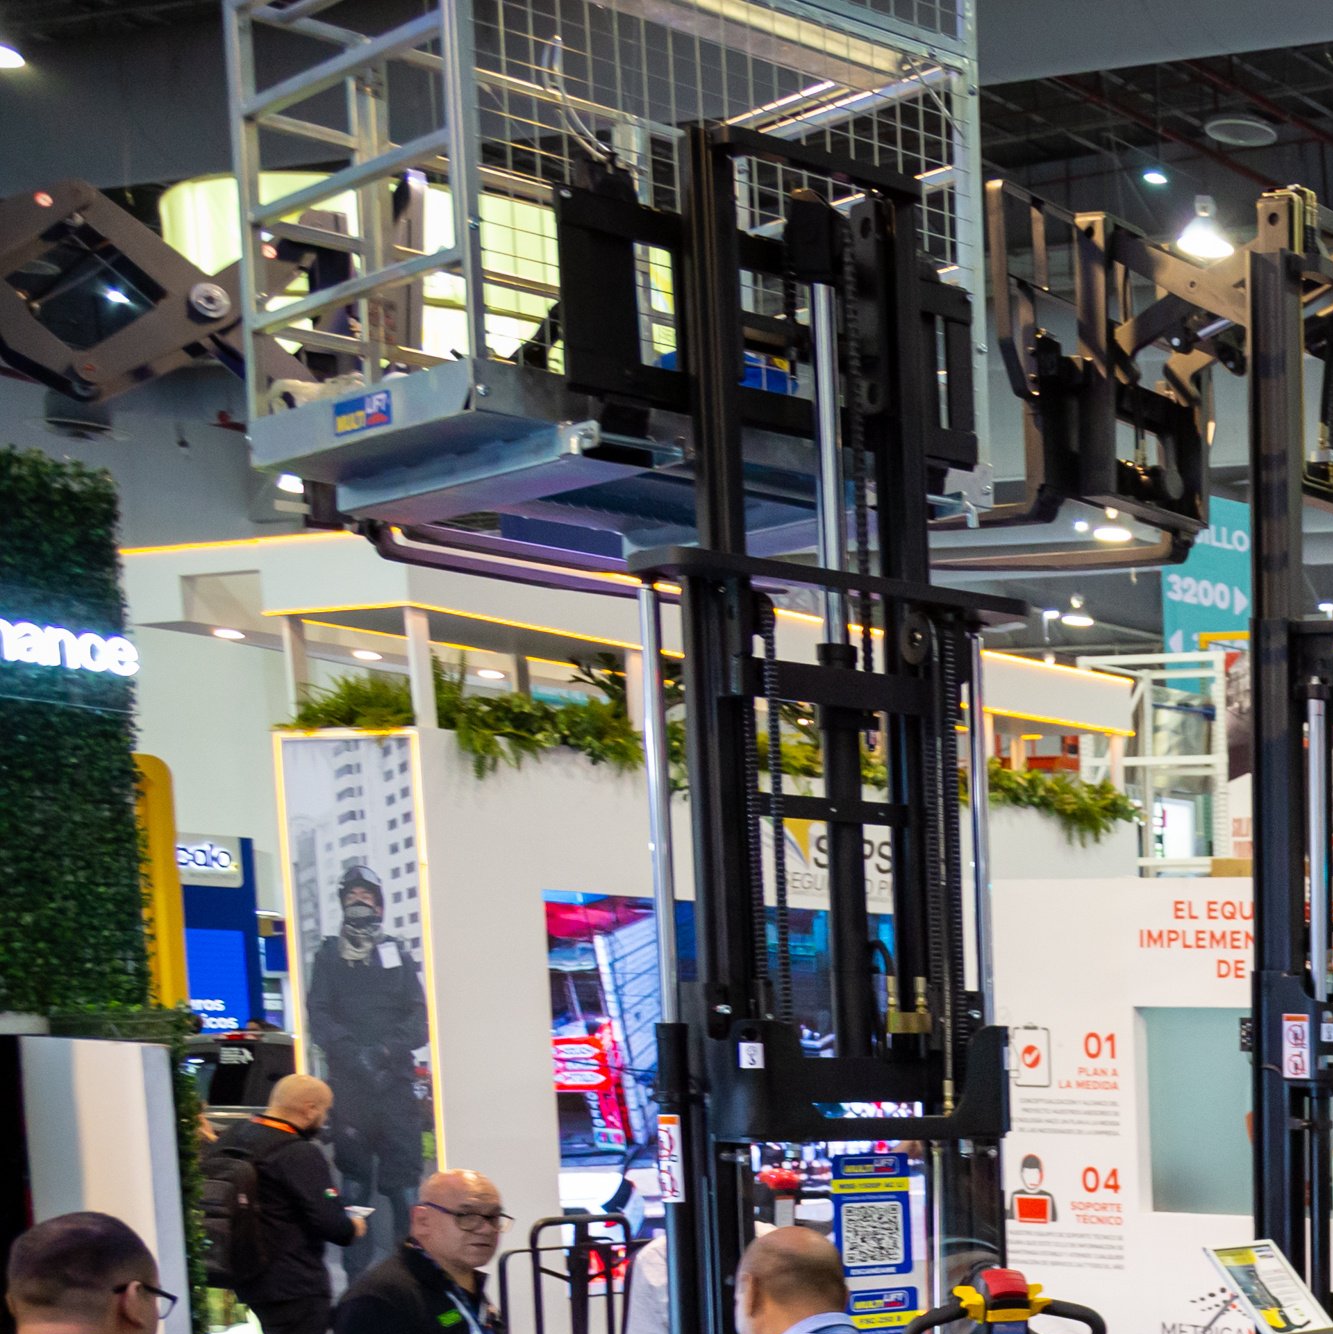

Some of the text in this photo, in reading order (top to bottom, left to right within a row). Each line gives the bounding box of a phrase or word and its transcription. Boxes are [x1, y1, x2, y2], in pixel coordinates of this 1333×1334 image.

[1166, 573, 1231, 610] 3200
[1173, 901, 1198, 920] EL
[1216, 959, 1245, 979] DE
[1084, 1032, 1117, 1059] 01
[1078, 1066, 1119, 1076] PLAN A
[1058, 1080, 1119, 1090] LA MEDIDA
[1082, 1166, 1121, 1194] 04
[1070, 1201, 1122, 1213] SOPORTE
